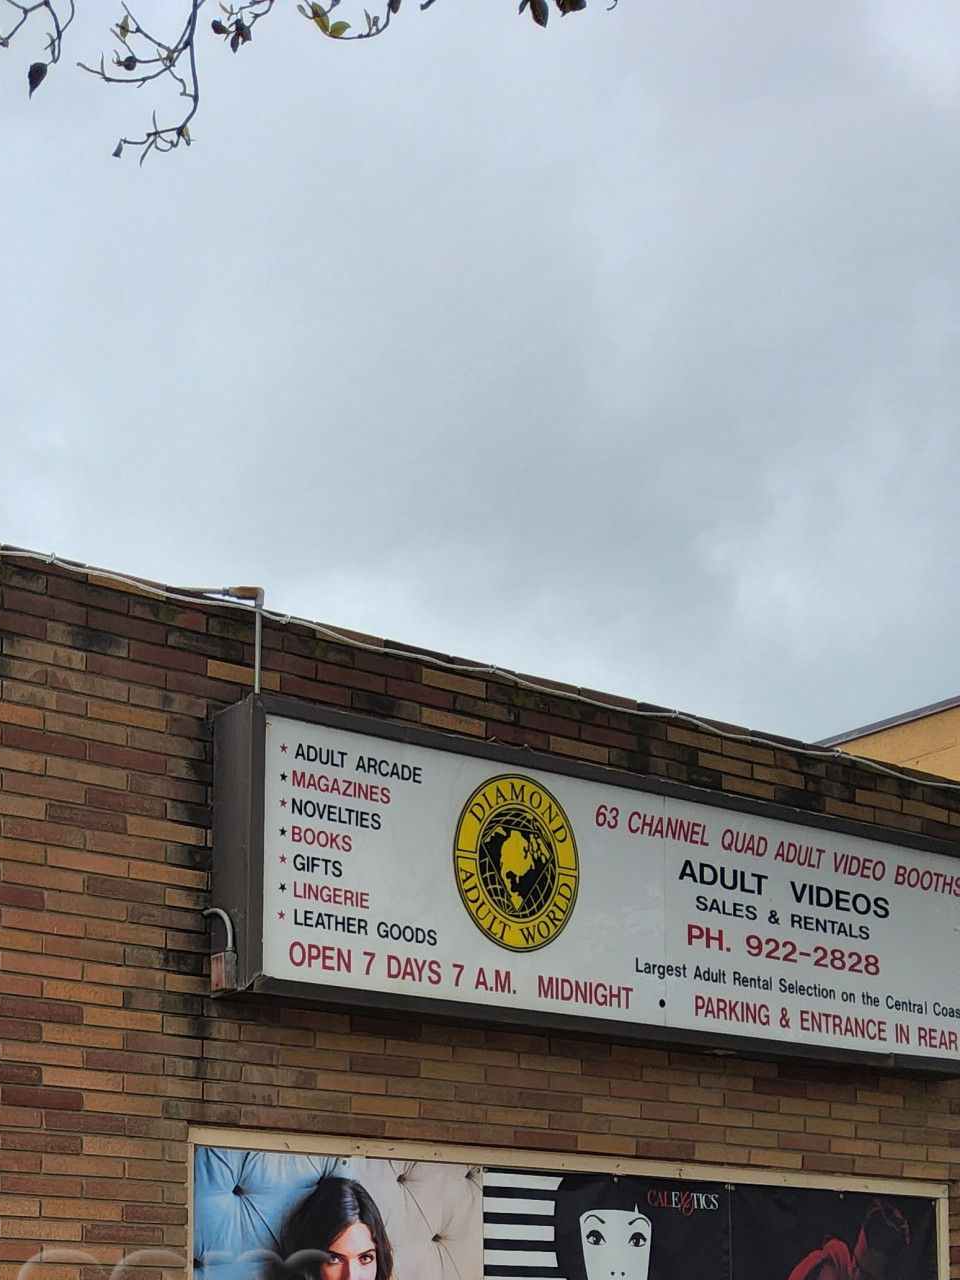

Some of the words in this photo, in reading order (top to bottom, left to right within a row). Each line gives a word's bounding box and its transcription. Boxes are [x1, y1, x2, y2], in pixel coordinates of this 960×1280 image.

[292, 770, 391, 804] MAGAZINES
[294, 743, 347, 768] ADULT
[355, 755, 423, 784] ARCADE
[291, 798, 382, 830] NOVELTIES
[469, 782, 568, 844] DIAMOND
[291, 826, 353, 852] BOOKS
[595, 804, 619, 830] 63
[628, 810, 710, 847] CHANNEL
[721, 828, 768, 858] QUAD
[774, 840, 825, 869] ADULT
[833, 852, 885, 882] VIDEO
[894, 864, 960, 897] BOOTHS
[293, 854, 343, 878] GIFTS
[678, 859, 768, 896] ADULT
[790, 880, 890, 919] VIDEOS
[293, 881, 370, 909] LINGERIE
[460, 867, 511, 941] ADULT
[519, 882, 573, 945] WORLD
[695, 895, 758, 921] SALES
[768, 909, 780, 925] &
[790, 914, 870, 940] RENTALS
[293, 909, 368, 936] LEATHER
[377, 922, 437, 946] GOODS
[687, 923, 731, 953] PH.
[745, 934, 880, 976] 922-2828
[289, 941, 352, 973] OPEN
[362, 951, 376, 975] 7
[387, 954, 442, 985] DAYS
[452, 963, 465, 987] 7
[475, 968, 517, 994] A.M.
[538, 975, 633, 1009] MIDNIGHT
[635, 957, 687, 980] Largest
[693, 965, 726, 985] Adult
[733, 972, 773, 992] Rental
[778, 978, 835, 1000] Selection
[841, 990, 855, 1003] on
[861, 991, 880, 1008] the
[885, 995, 928, 1016] Central
[694, 995, 770, 1027] PARKING
[779, 1009, 791, 1029] &
[800, 1010, 887, 1042] ENTRANCE
[895, 1023, 910, 1046] IN
[918, 1027, 959, 1051] REAR
